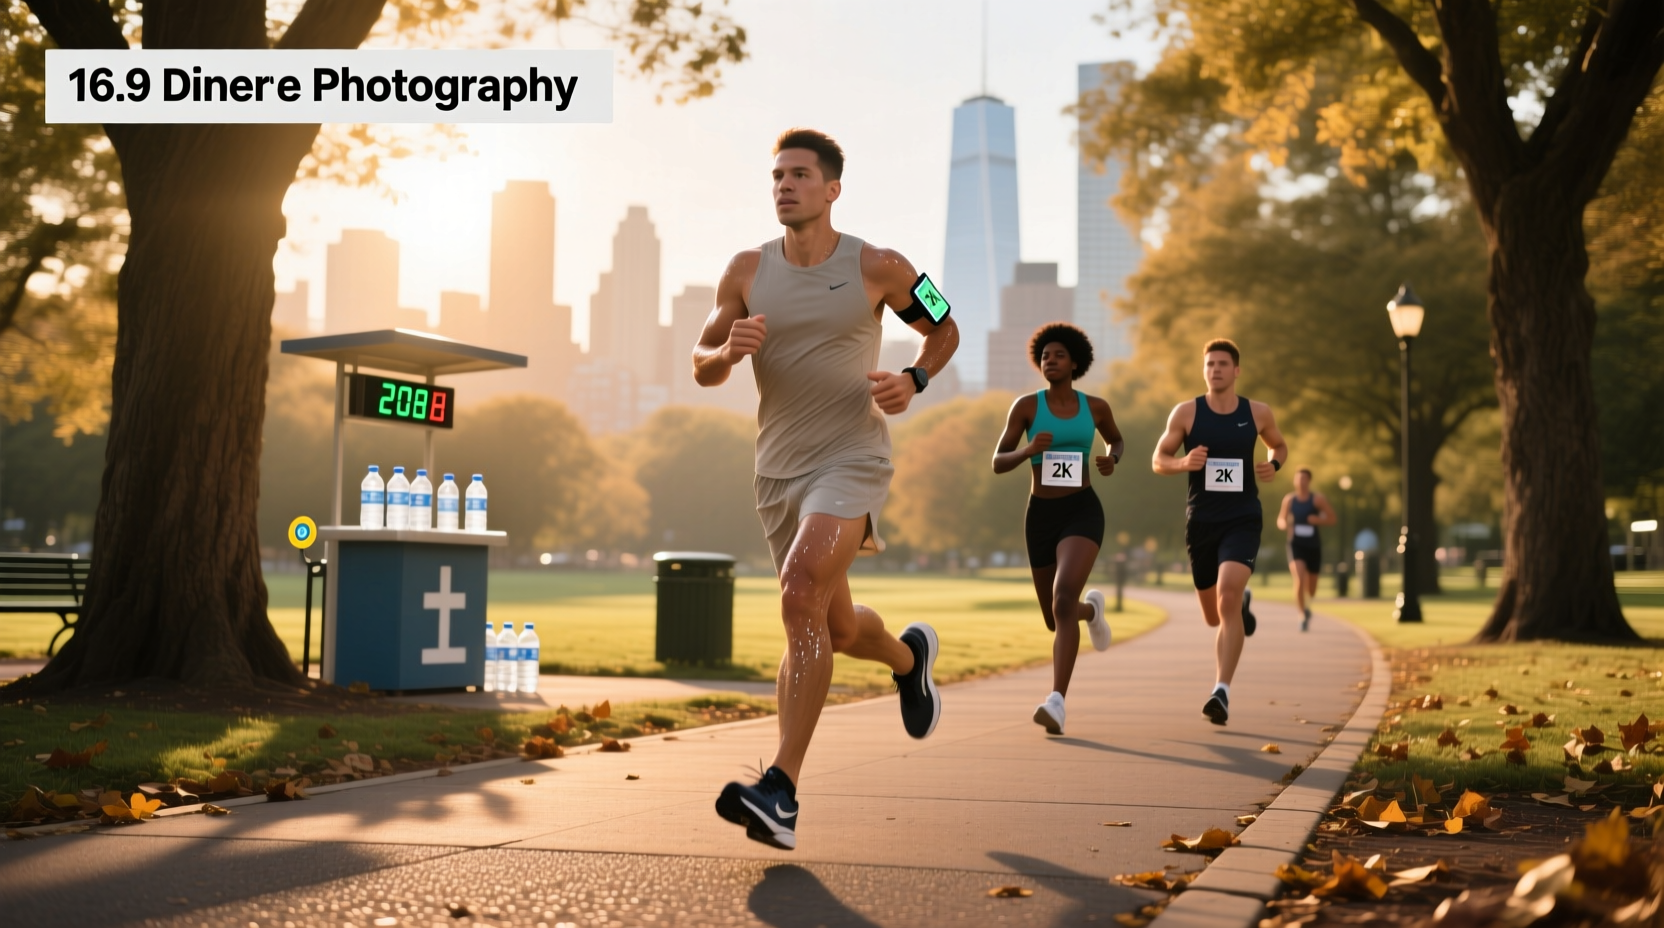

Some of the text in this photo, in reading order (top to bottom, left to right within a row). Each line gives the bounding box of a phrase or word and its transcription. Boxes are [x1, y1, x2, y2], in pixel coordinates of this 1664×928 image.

[379, 382, 447, 422] 2088
[1052, 461, 1073, 479] 2K
[1215, 468, 1233, 483] 2K
